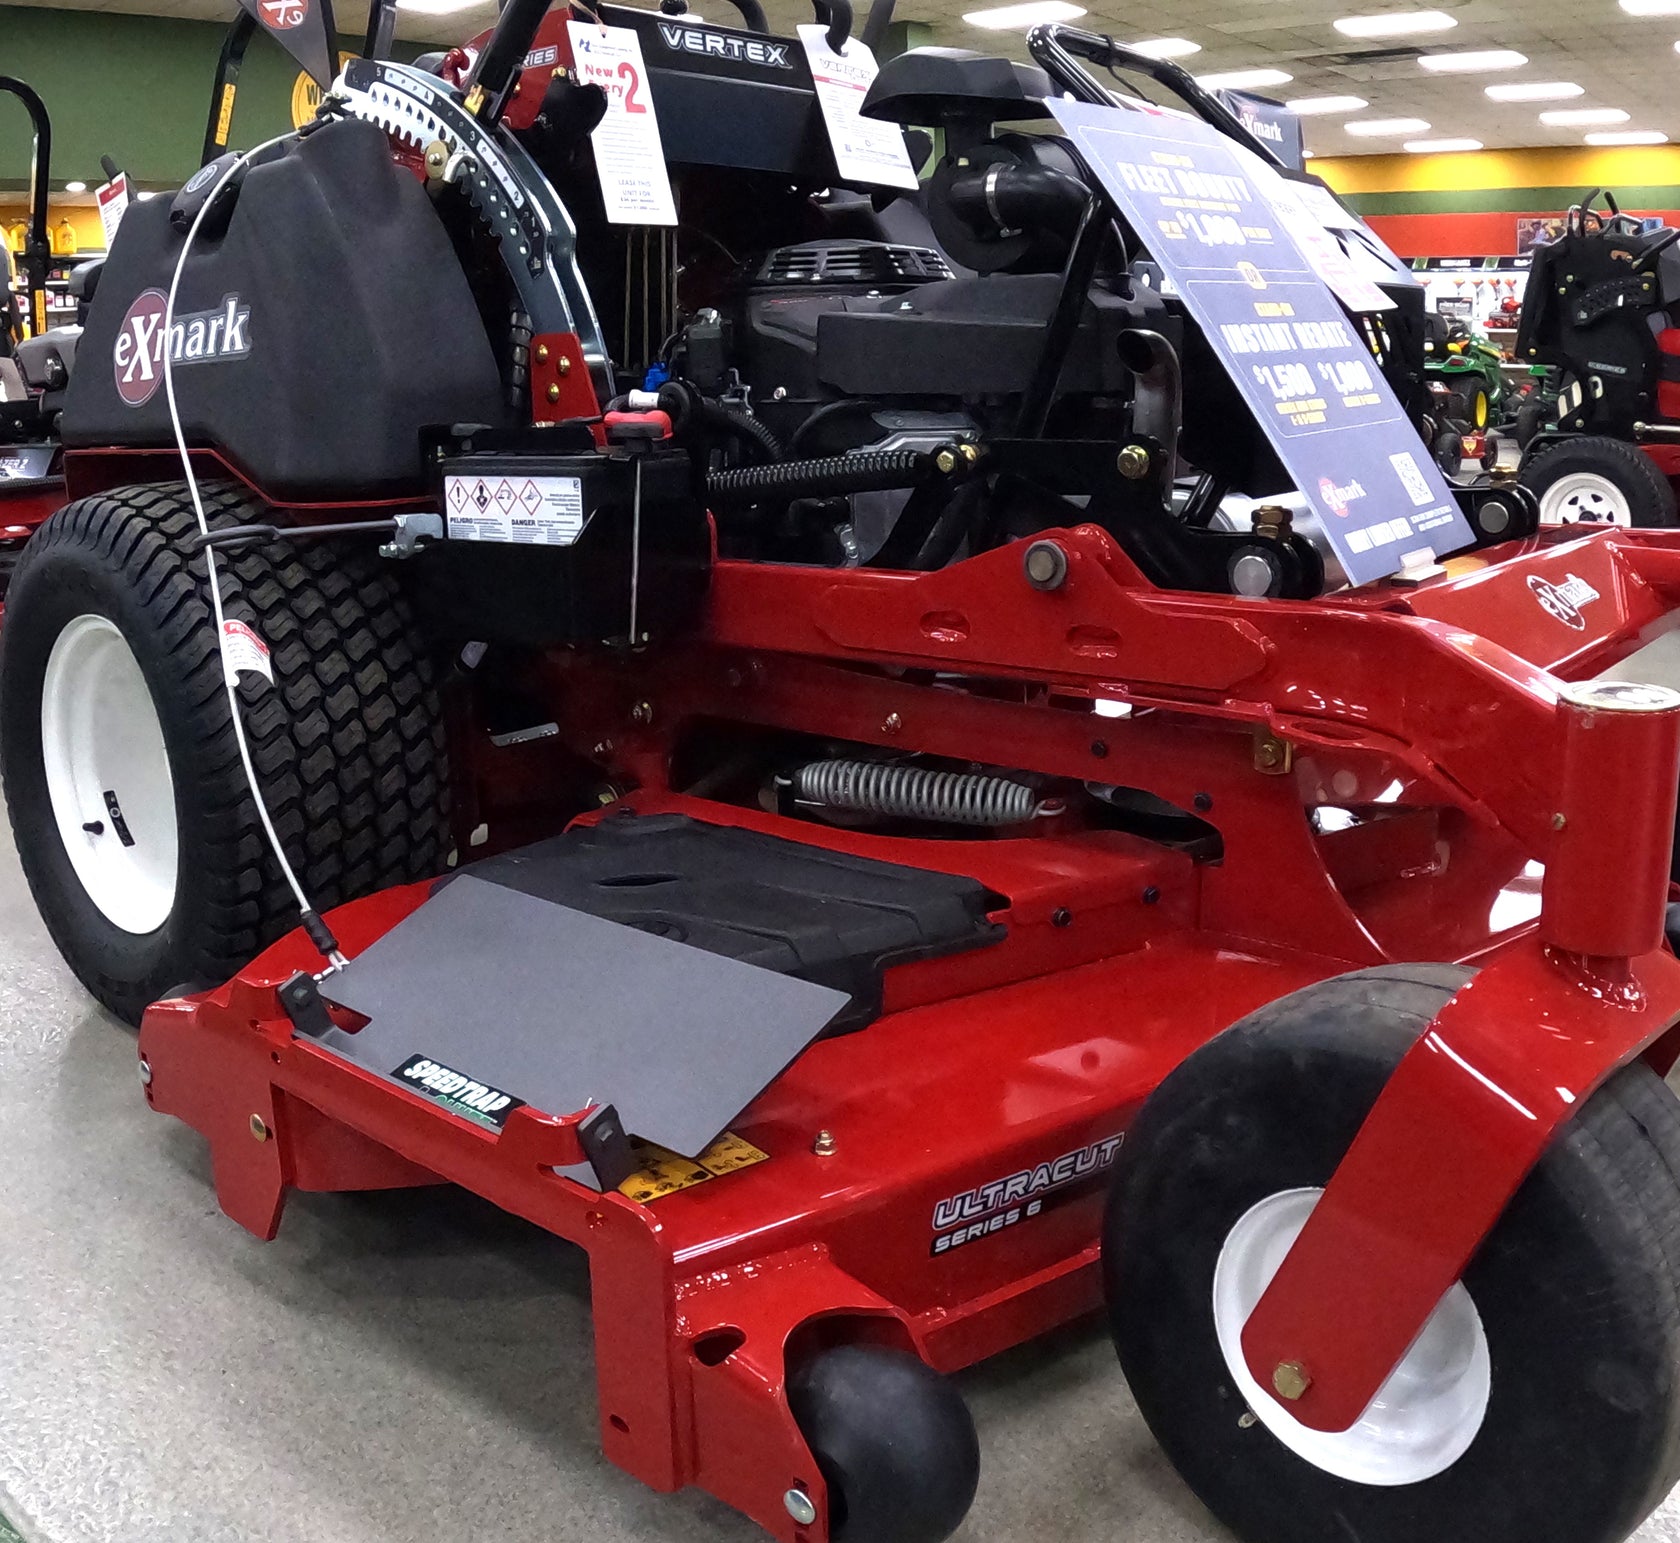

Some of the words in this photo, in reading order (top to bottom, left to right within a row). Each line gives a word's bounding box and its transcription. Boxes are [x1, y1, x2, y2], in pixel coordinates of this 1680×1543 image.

[523, 49, 555, 67] RIES
[660, 24, 788, 66] VERTEX
[584, 64, 613, 78] New
[617, 62, 647, 114] 2
[587, 79, 624, 97] ery
[469, 131, 476, 141] 3
[513, 191, 519, 201] 2
[1116, 161, 1179, 195] FLEET
[115, 298, 249, 383] eXmark
[1219, 322, 1298, 354] INSTANT
[1292, 320, 1352, 350] REBATE
[1252, 362, 1317, 401] $1,500
[449, 516, 474, 525] PELIGRO
[511, 518, 537, 527] DANGER
[403, 1059, 512, 1113] SPEEDTRAP
[934, 1134, 1123, 1229] ULTRACUT
[934, 1207, 1021, 1253] SERIES
[1026, 1199, 1043, 1217] 6
